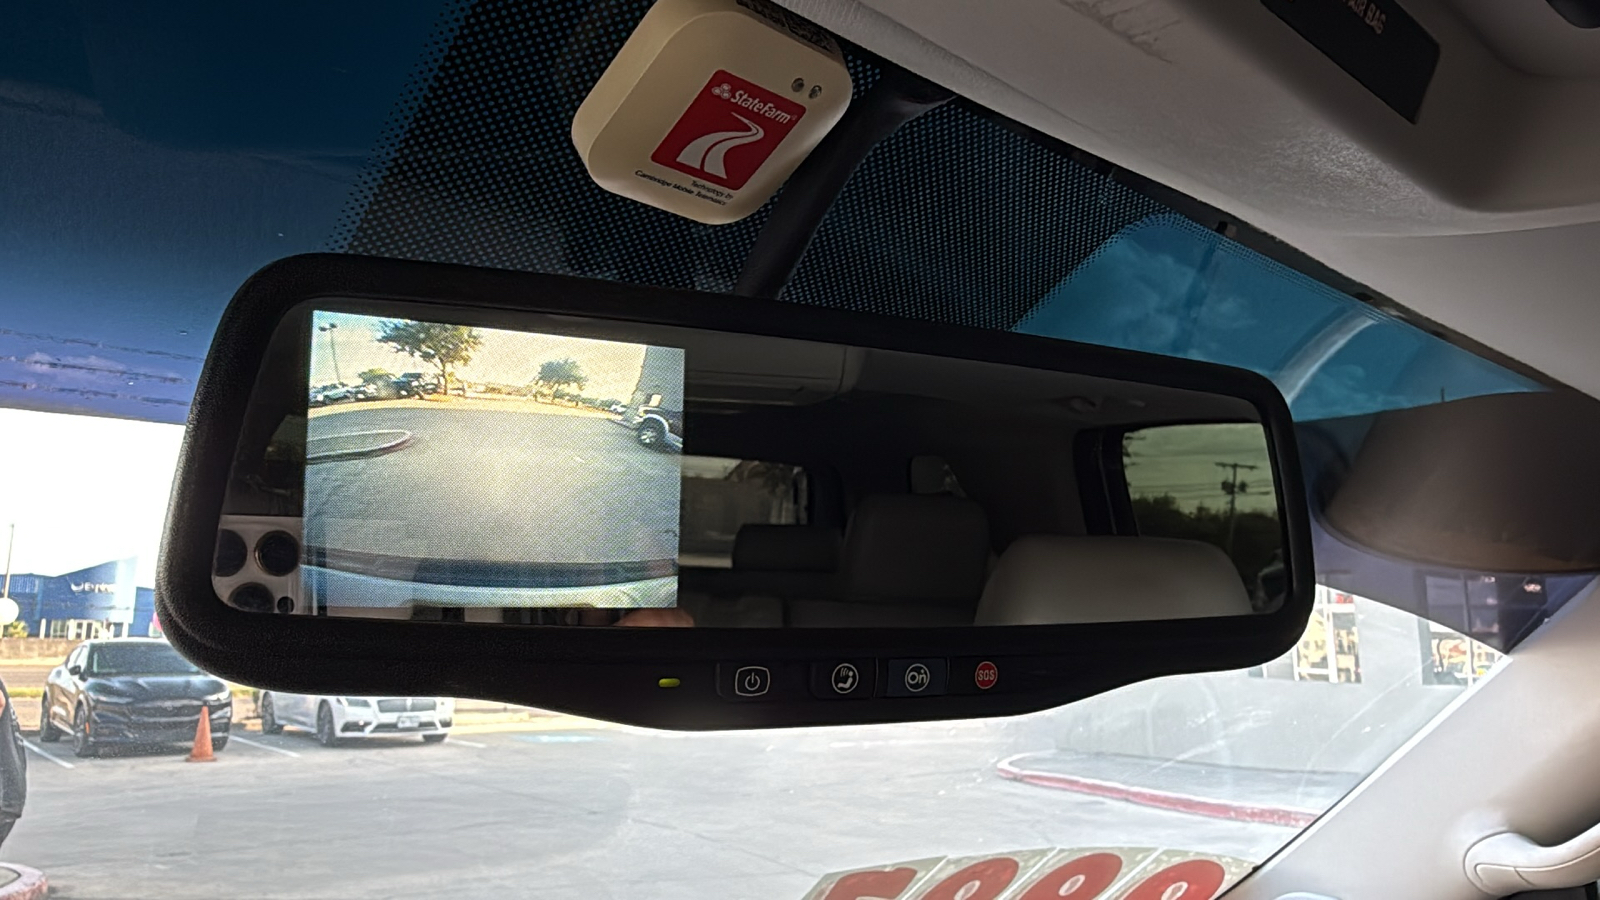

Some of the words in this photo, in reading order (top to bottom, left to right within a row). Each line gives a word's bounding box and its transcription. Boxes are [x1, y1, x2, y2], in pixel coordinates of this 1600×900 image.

[1364, 2, 1386, 35] BAG
[635, 169, 672, 187] Cambridge
[672, 184, 694, 195] Mobile
[691, 180, 724, 197] Technology
[977, 669, 995, 681] SOS
